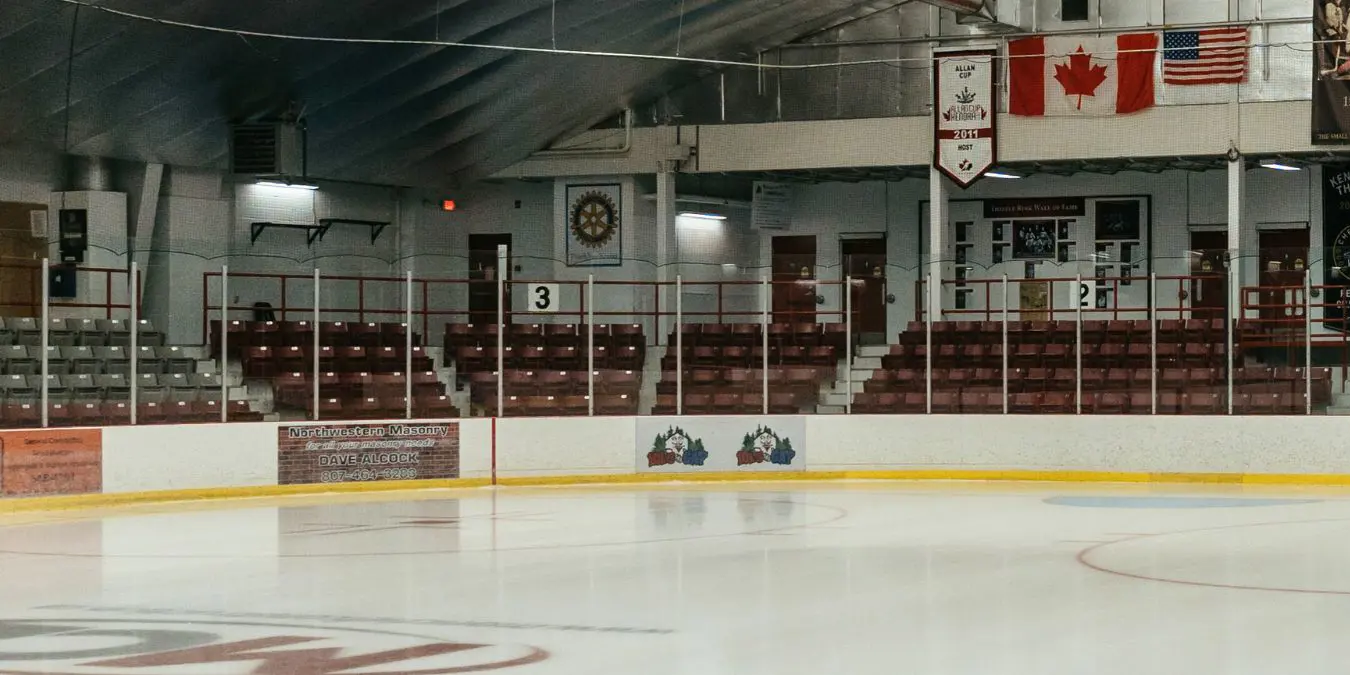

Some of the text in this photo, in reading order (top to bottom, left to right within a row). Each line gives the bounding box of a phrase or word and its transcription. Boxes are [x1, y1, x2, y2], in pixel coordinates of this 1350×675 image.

[955, 64, 975, 72] ALLAN
[953, 129, 979, 139] 2011
[535, 286, 550, 309] 3
[1080, 283, 1089, 306] 2
[288, 424, 449, 438] Northwestern Masonry
[305, 440, 321, 450] for
[337, 441, 360, 450] your
[361, 439, 401, 449] masonry
[318, 454, 357, 467] DAVE
